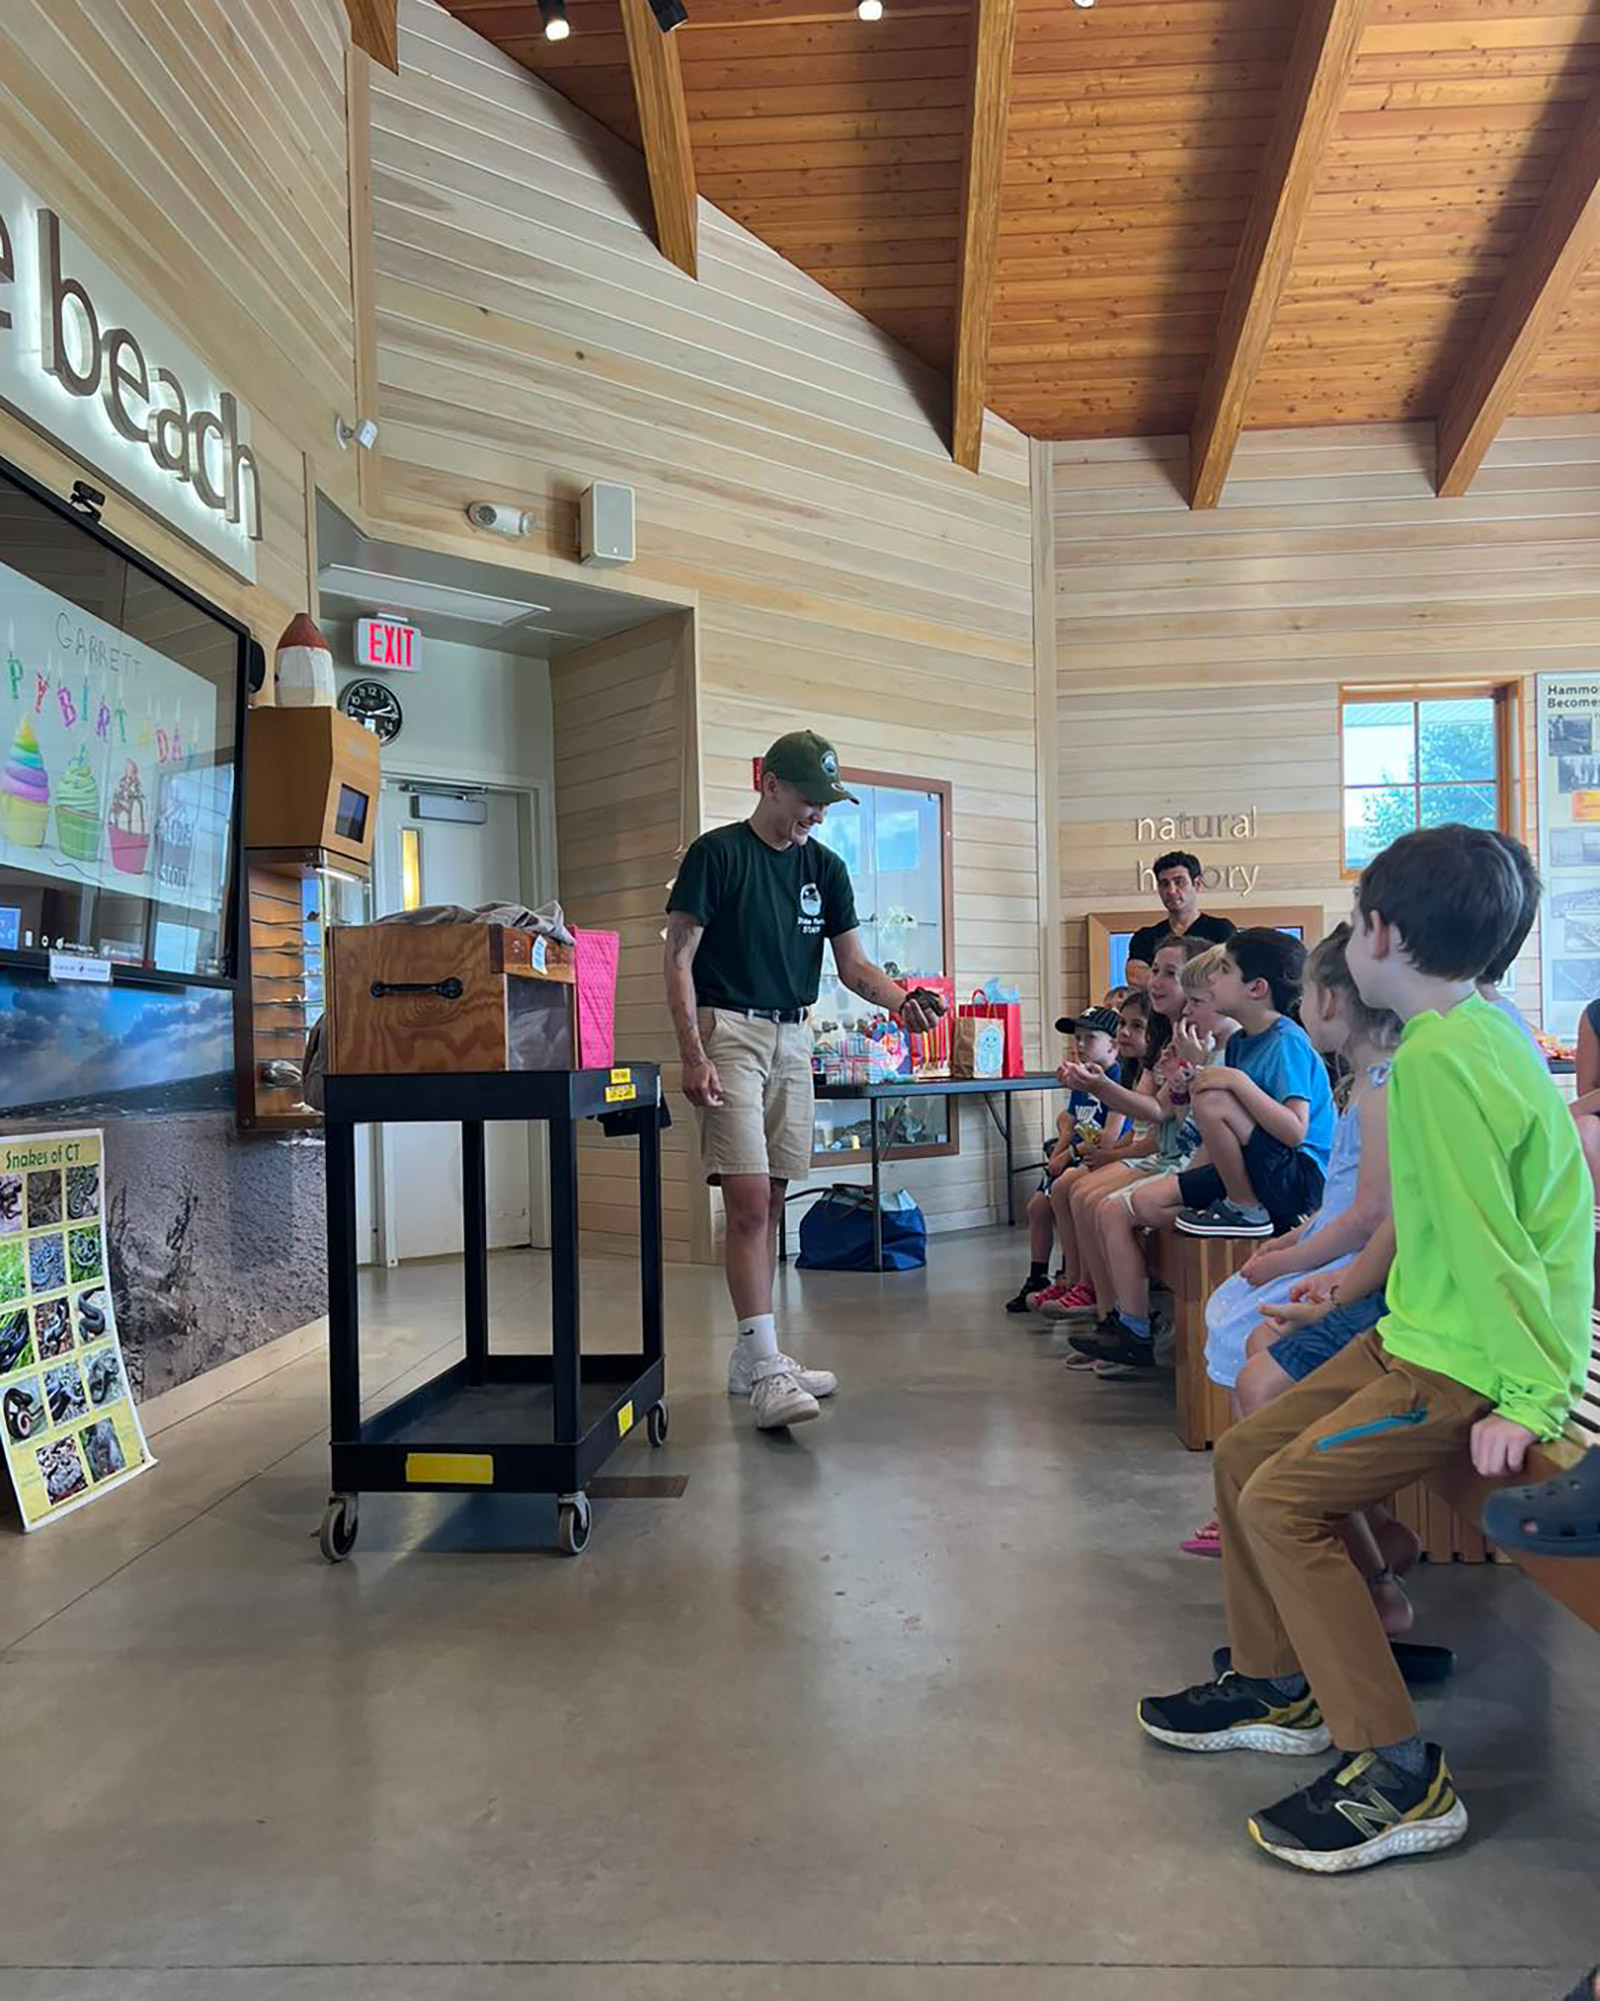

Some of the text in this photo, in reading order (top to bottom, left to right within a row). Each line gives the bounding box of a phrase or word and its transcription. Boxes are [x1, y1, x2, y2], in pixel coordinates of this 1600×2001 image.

[37, 208, 263, 541] beach
[56, 612, 142, 677] GARRETT
[369, 622, 414, 666] EXIT
[1136, 805, 1257, 841] natural
[1137, 859, 1259, 897] hory
[6, 1143, 81, 1169] Snakes of CT
